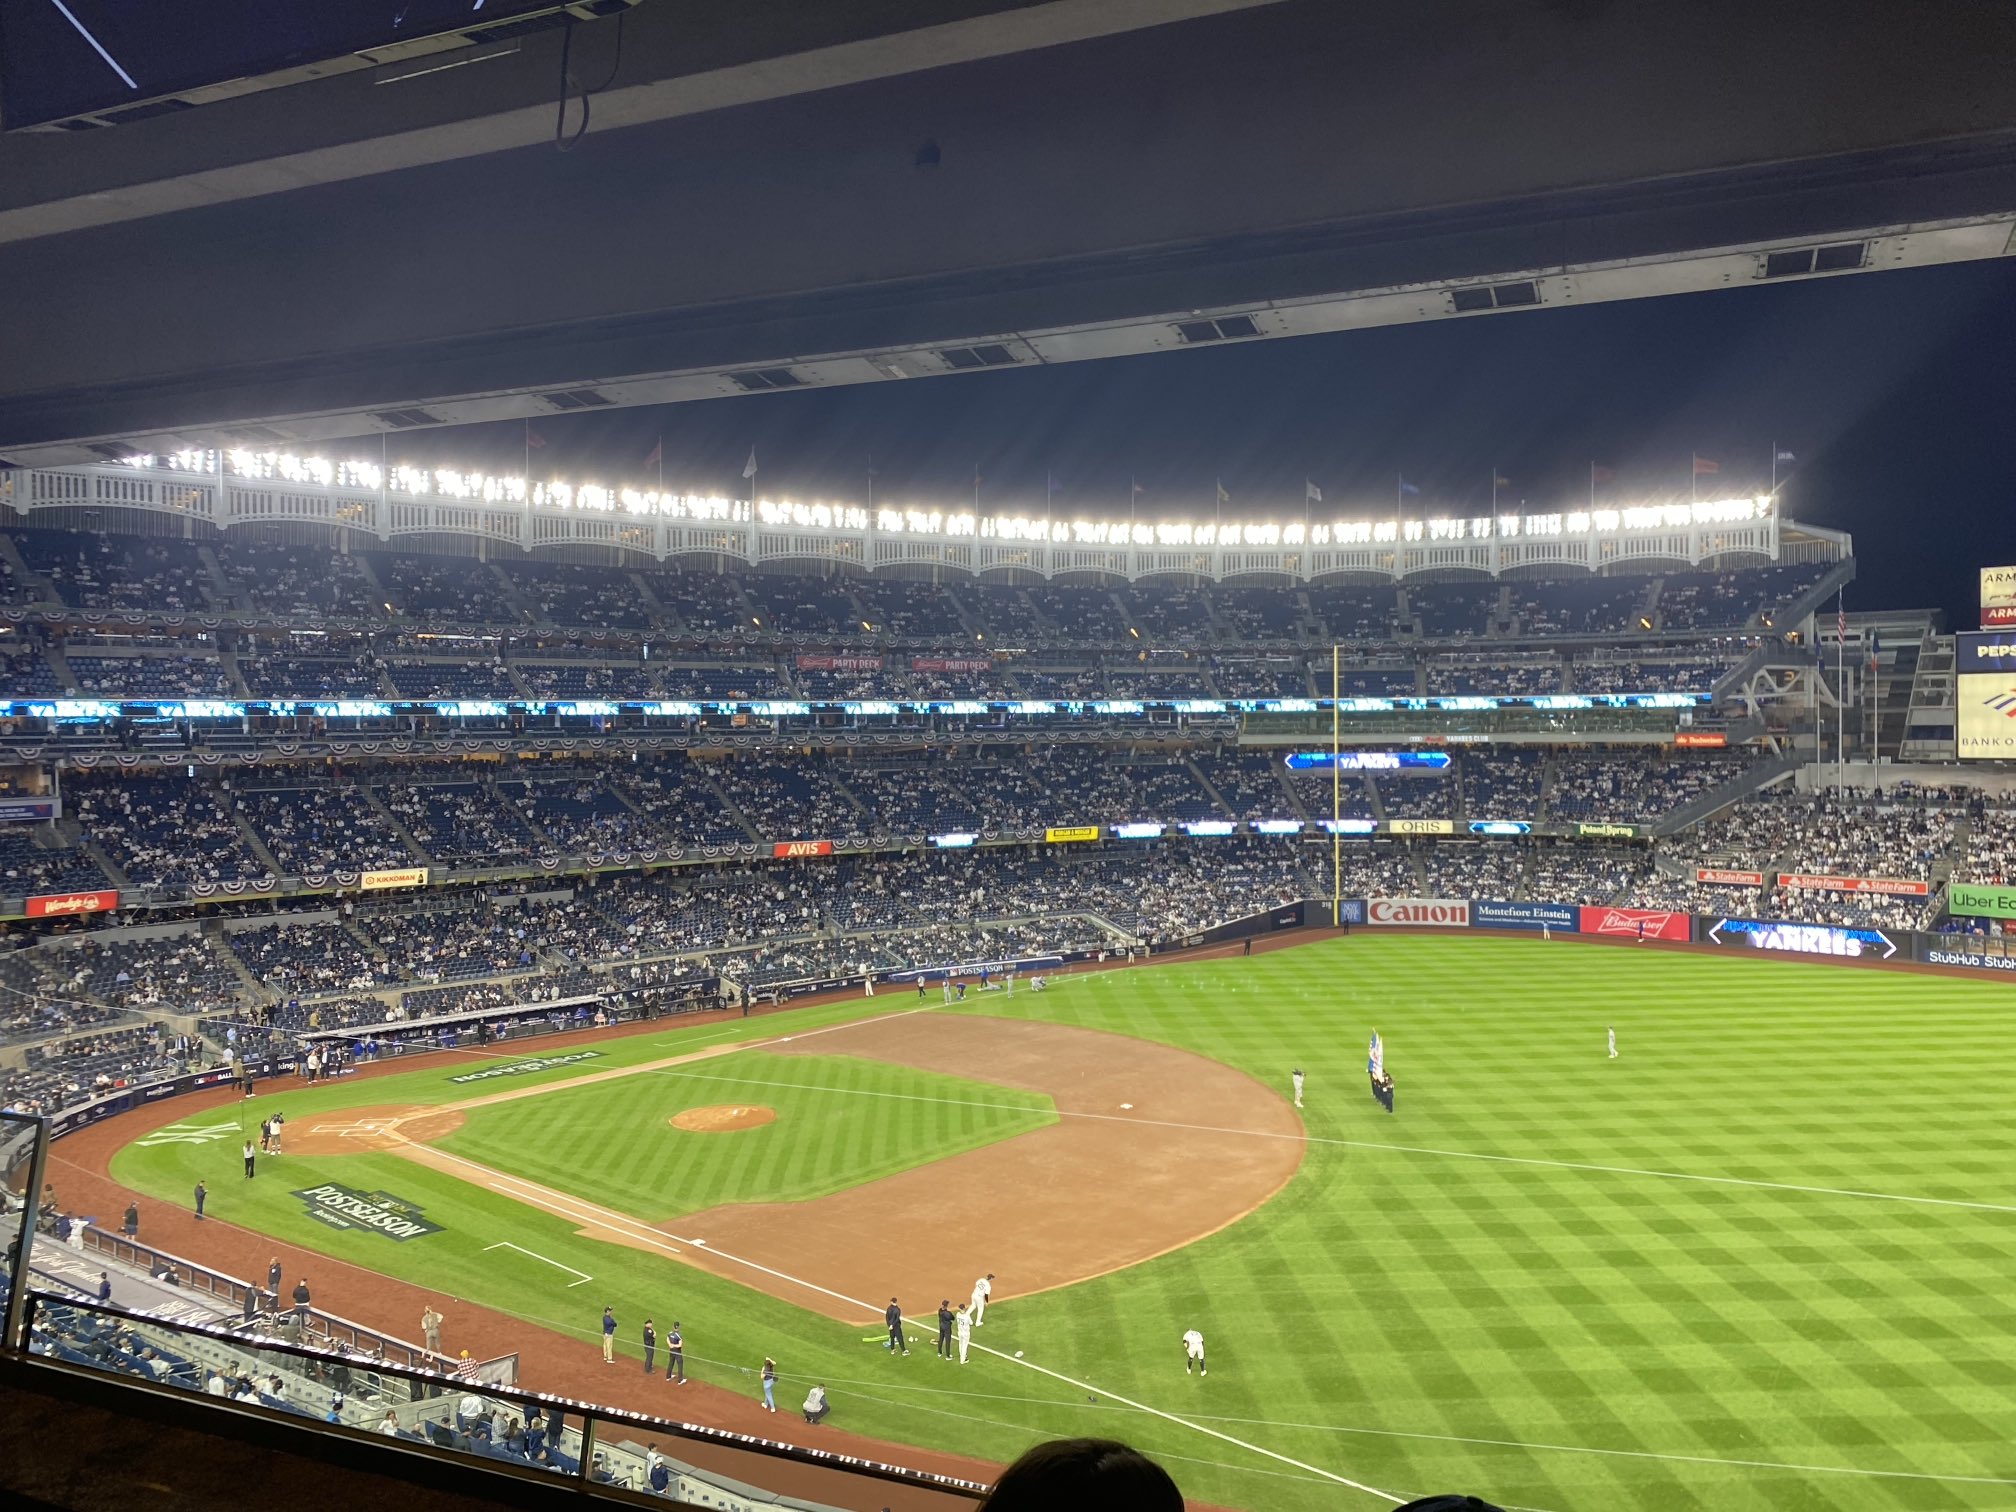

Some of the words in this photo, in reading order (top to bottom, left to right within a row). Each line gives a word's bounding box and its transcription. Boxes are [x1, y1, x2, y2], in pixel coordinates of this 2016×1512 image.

[833, 659, 857, 669] PARTY
[859, 659, 880, 668] DECK
[945, 660, 971, 670] PARTY
[972, 661, 989, 670] DECK
[1962, 737, 2000, 746] BANK
[1402, 820, 1440, 832] ORIS
[1580, 824, 1605, 835] Poland
[1606, 824, 1633, 837] Spring
[787, 843, 818, 856] AVIS
[376, 874, 416, 883] KIKKOMAN
[45, 896, 82, 914] Wendy's
[1953, 893, 1994, 908] Uber
[1369, 901, 1467, 923] Canon
[1479, 905, 1531, 918] Montefiore
[1533, 908, 1571, 920] Einstein
[1606, 915, 1664, 929] Budweiser
[1751, 929, 1861, 957] YANKEES
[1929, 951, 1980, 966] StubHub
[453, 1051, 599, 1082] POSTSEASON
[217, 1072, 233, 1080] BALL
[302, 1184, 428, 1238] POSTSEASON
